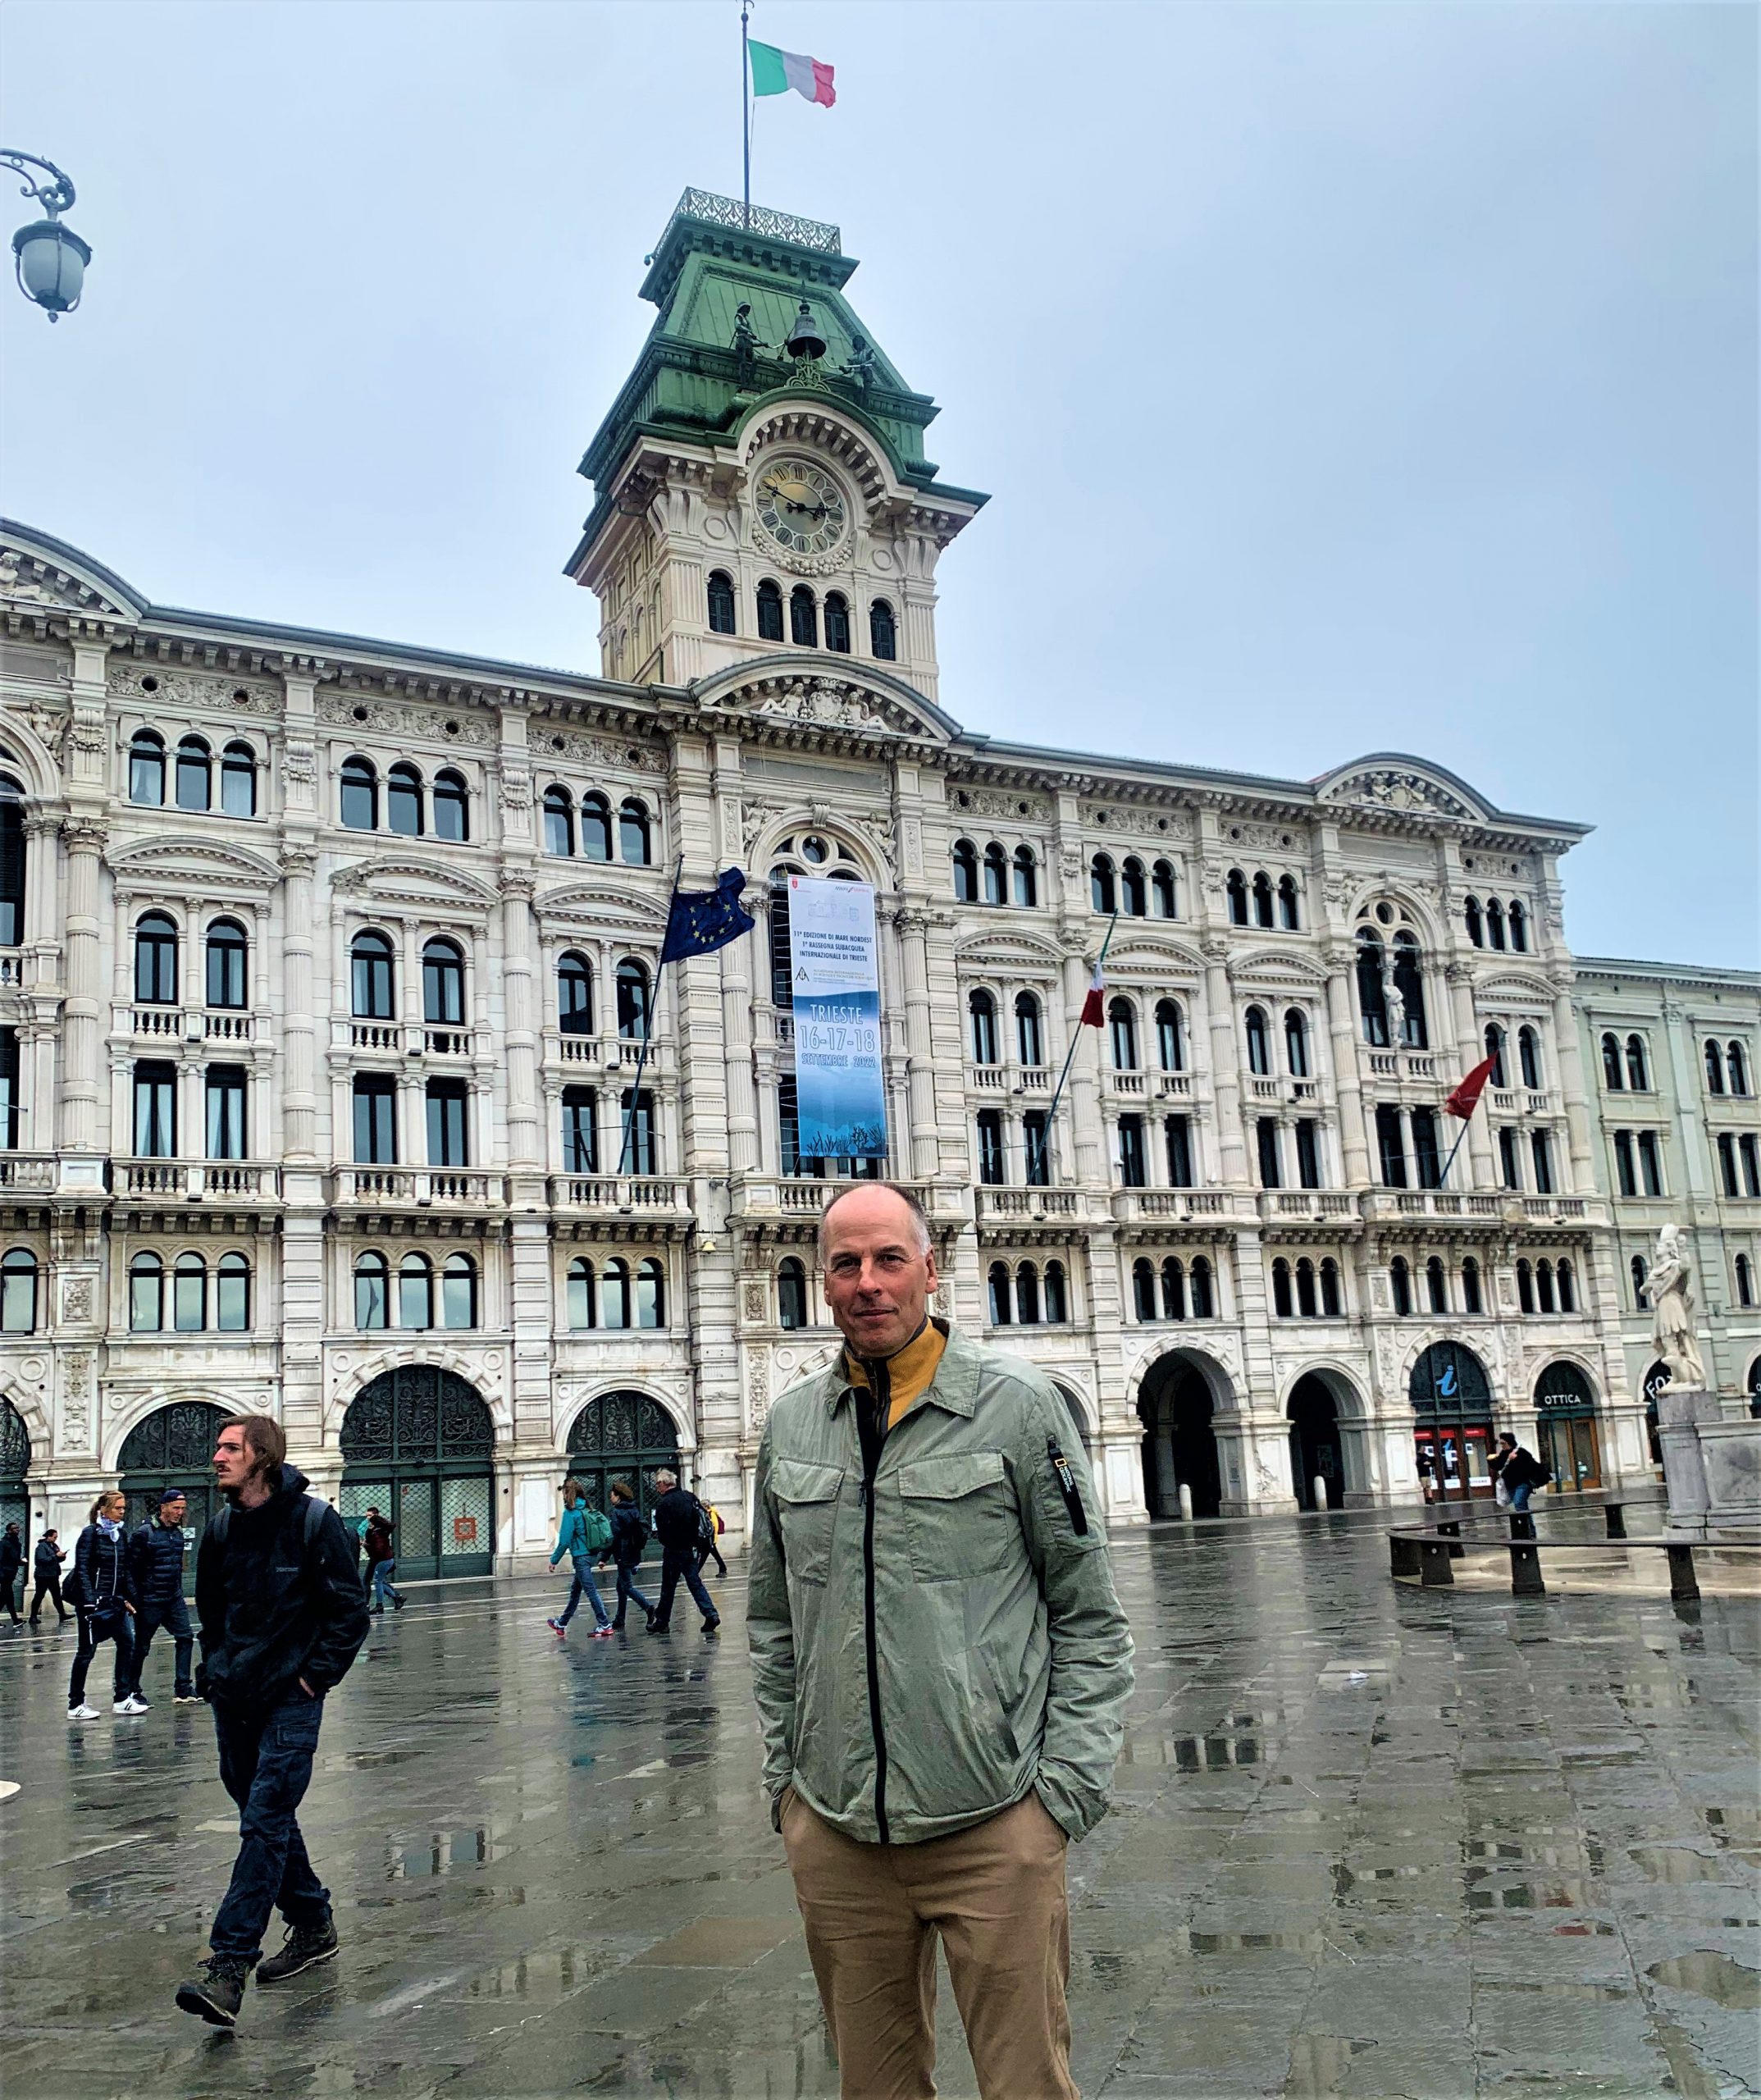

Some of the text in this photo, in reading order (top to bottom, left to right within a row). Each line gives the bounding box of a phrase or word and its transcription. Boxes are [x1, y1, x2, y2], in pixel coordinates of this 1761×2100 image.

[804, 932, 827, 940] EDIZIONE
[850, 935, 872, 943] NORDEST
[800, 950, 842, 960] INTERNAZIONALE
[809, 942, 834, 950] RASSEGNA
[835, 944, 865, 952] SUBACQUEA
[810, 1004, 864, 1025] TRIESTE
[800, 1025, 875, 1052] 16-17-18
[801, 1052, 876, 1068] SETTEMBRE 2022
[1544, 1394, 1581, 1405] OTTICA
[1059, 1468, 1072, 1493] GEOGRAPHIC
[1063, 1466, 1074, 1486] NATIONAL
